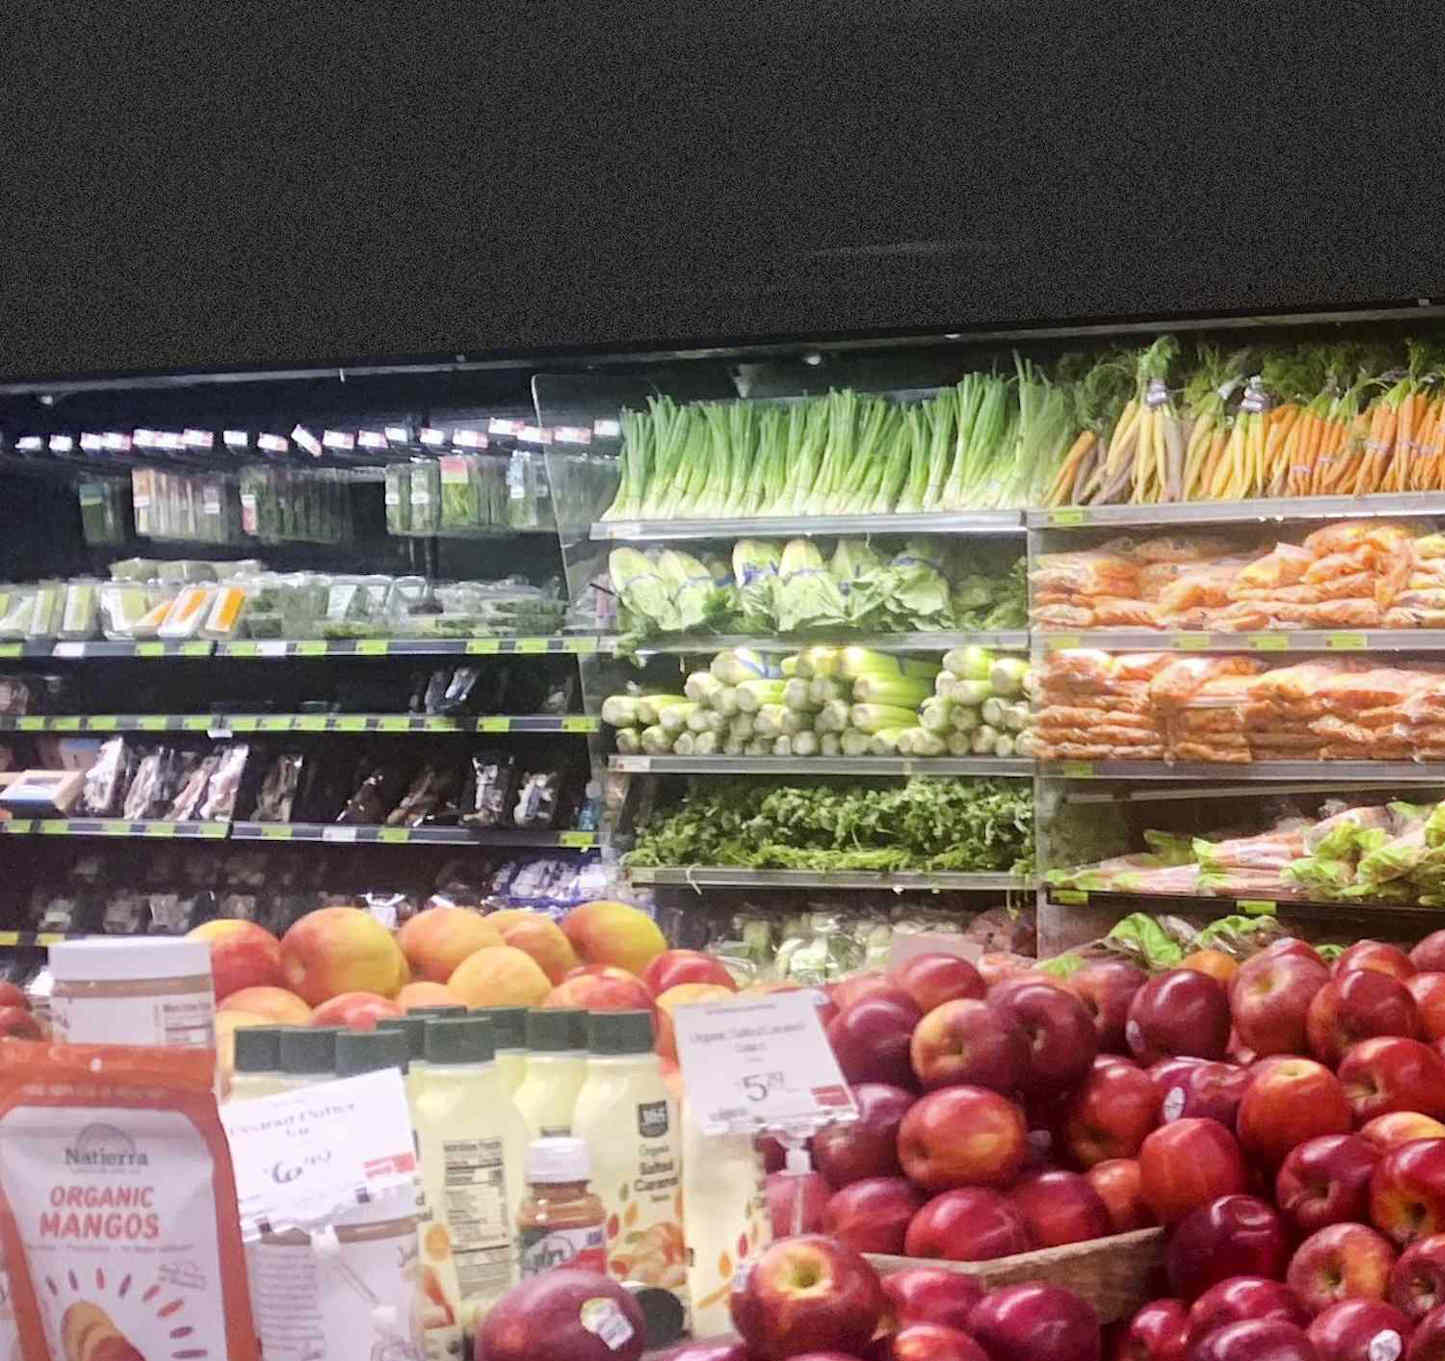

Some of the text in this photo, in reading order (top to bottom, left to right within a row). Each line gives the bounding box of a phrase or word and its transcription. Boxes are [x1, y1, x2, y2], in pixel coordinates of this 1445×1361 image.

[64, 1147, 149, 1167] Natierra
[49, 1185, 155, 1209] ORGANIC
[39, 1211, 161, 1240] MANGOS
